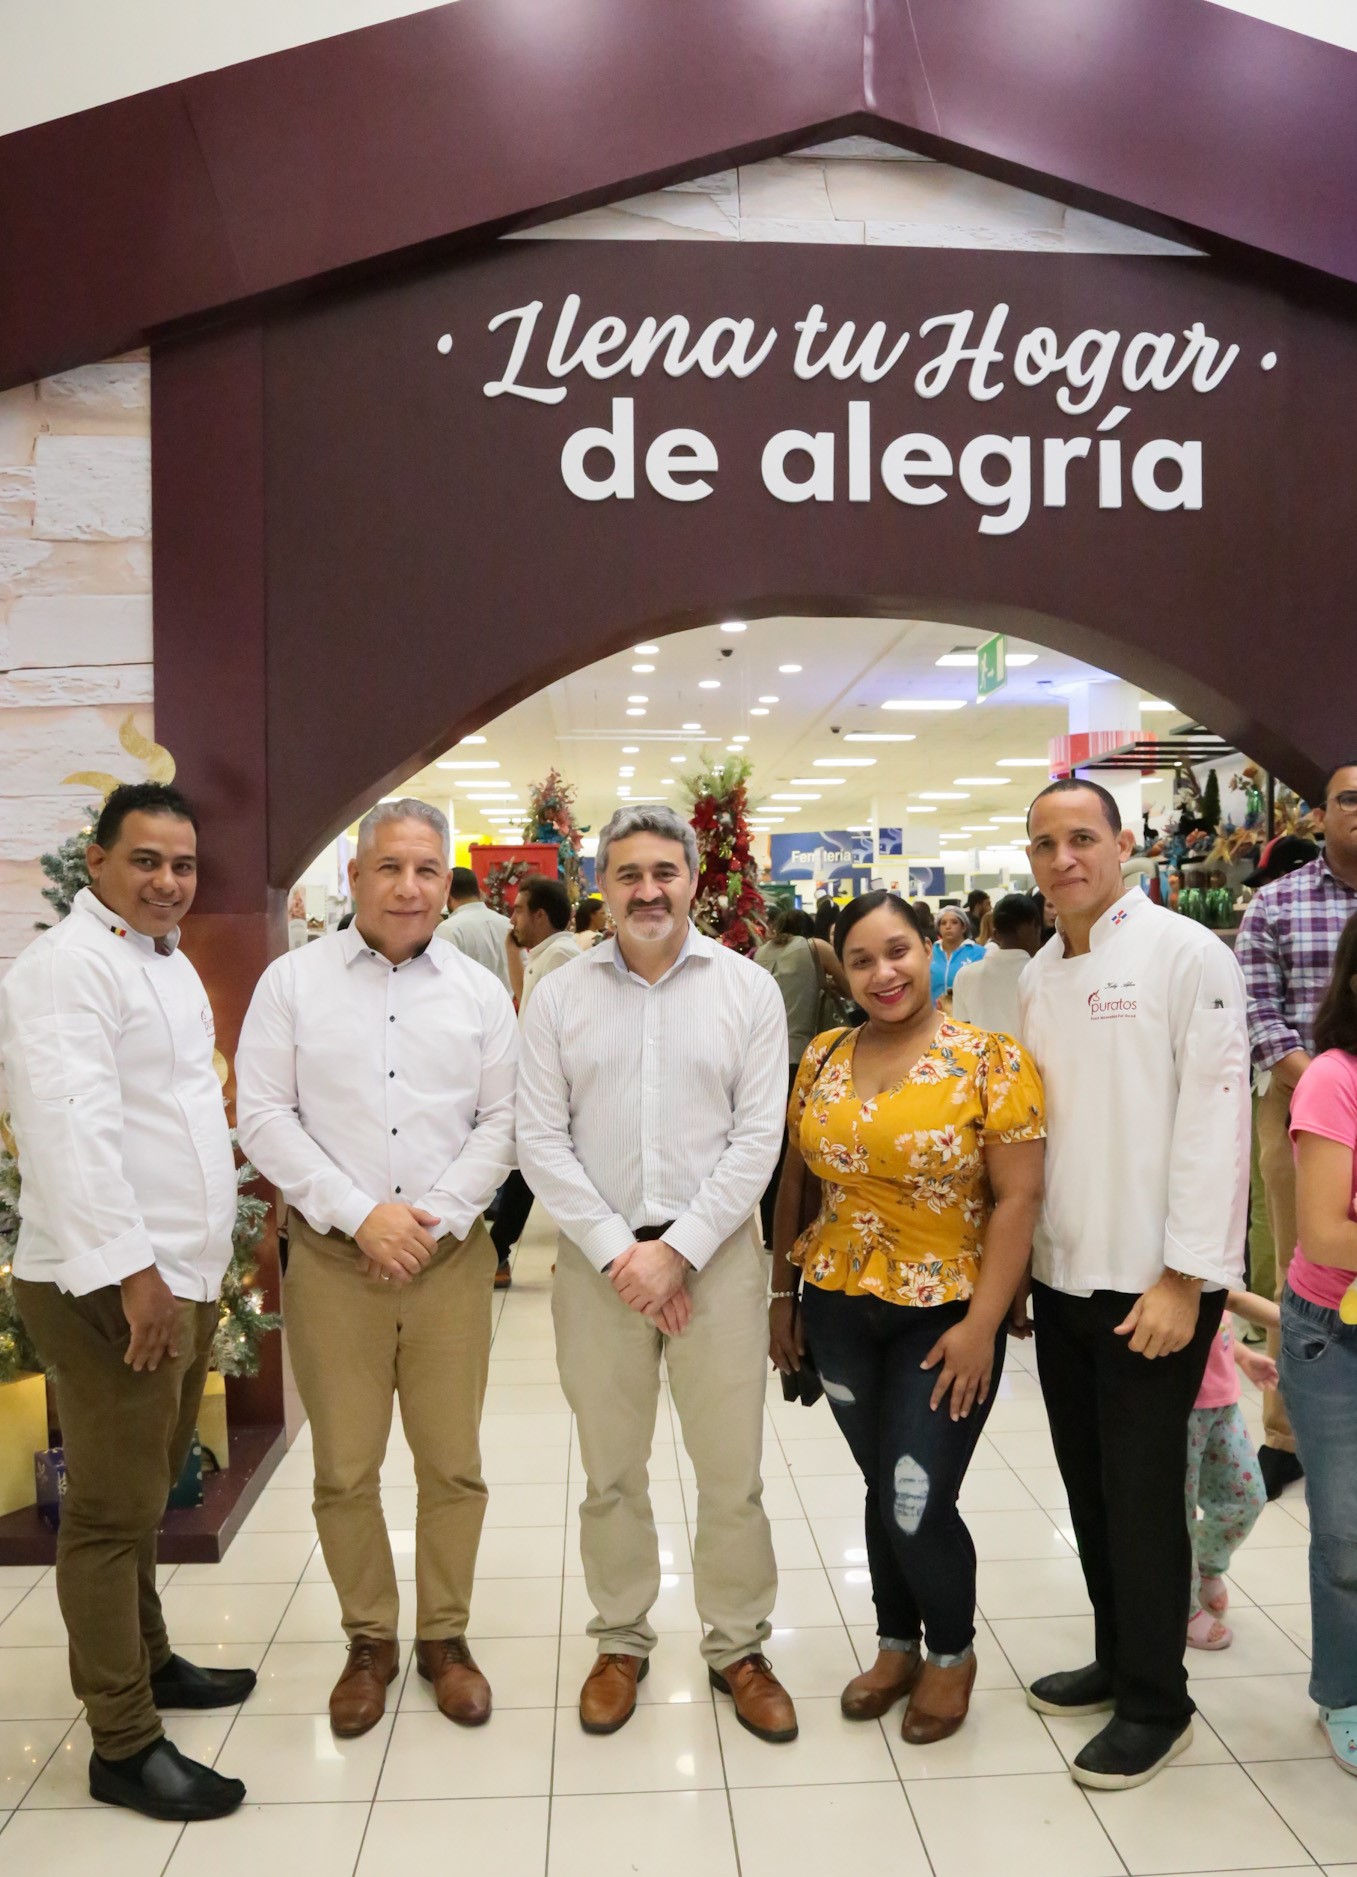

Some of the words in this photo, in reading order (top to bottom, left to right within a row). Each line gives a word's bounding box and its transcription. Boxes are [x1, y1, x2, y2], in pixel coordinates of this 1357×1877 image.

[483, 294, 777, 404] Llena
[793, 303, 910, 382] tu
[914, 302, 1241, 414] Hogar
[560, 397, 719, 501] de
[761, 401, 1203, 535] alegría
[1091, 998, 1137, 1015] puratos
